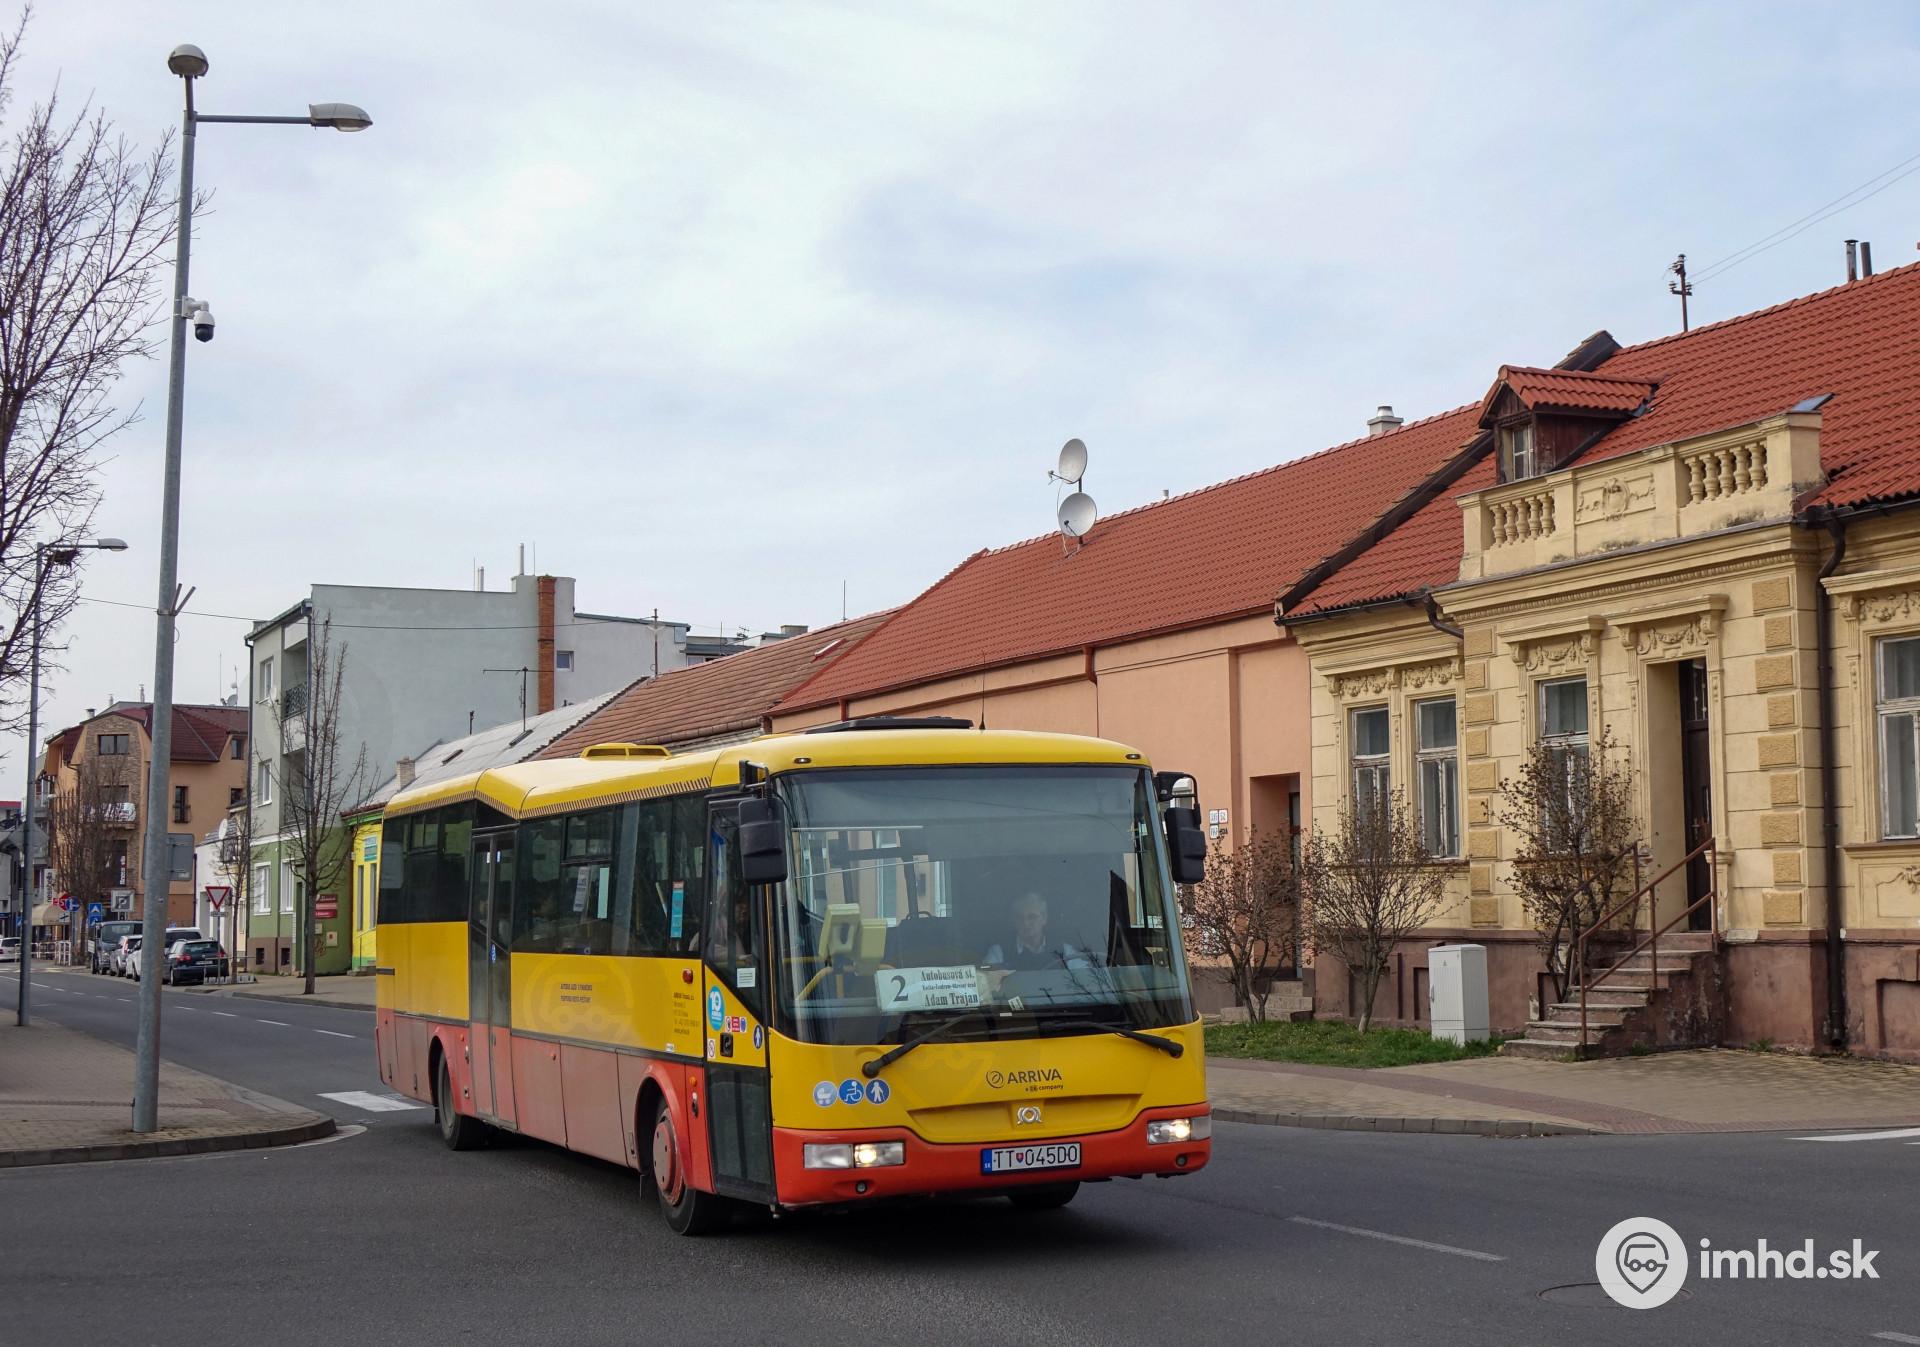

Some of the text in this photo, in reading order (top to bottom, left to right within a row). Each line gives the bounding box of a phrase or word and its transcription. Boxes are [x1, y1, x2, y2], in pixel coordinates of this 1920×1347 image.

[921, 968, 964, 982] Autobusová
[890, 975, 909, 1002] 2
[709, 991, 722, 1011] 10
[924, 992, 979, 1007] Adam Trajan
[1007, 1068, 1062, 1084] ARRIVA
[1038, 1084, 1064, 1092] company
[994, 1150, 1015, 1168] TT
